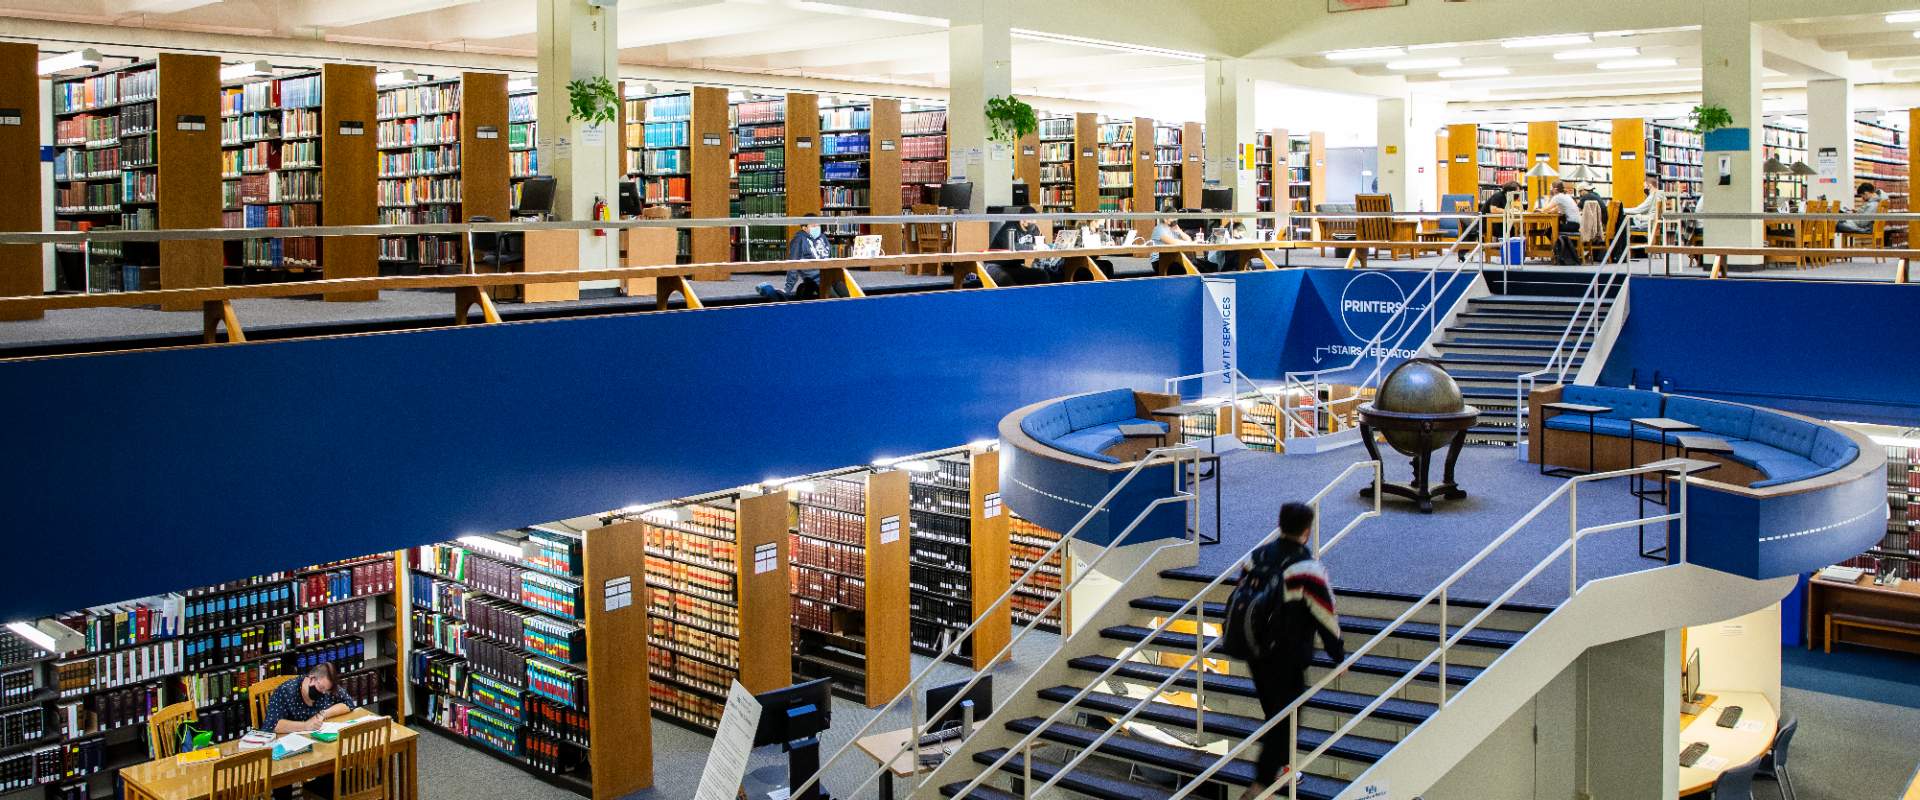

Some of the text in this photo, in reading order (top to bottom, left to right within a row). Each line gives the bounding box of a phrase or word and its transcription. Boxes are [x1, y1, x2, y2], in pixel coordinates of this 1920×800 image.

[1344, 299, 1403, 313] PRINTERS
[1222, 296, 1231, 384] LAW IT SERVICES
[1331, 345, 1363, 356] STAIRS
